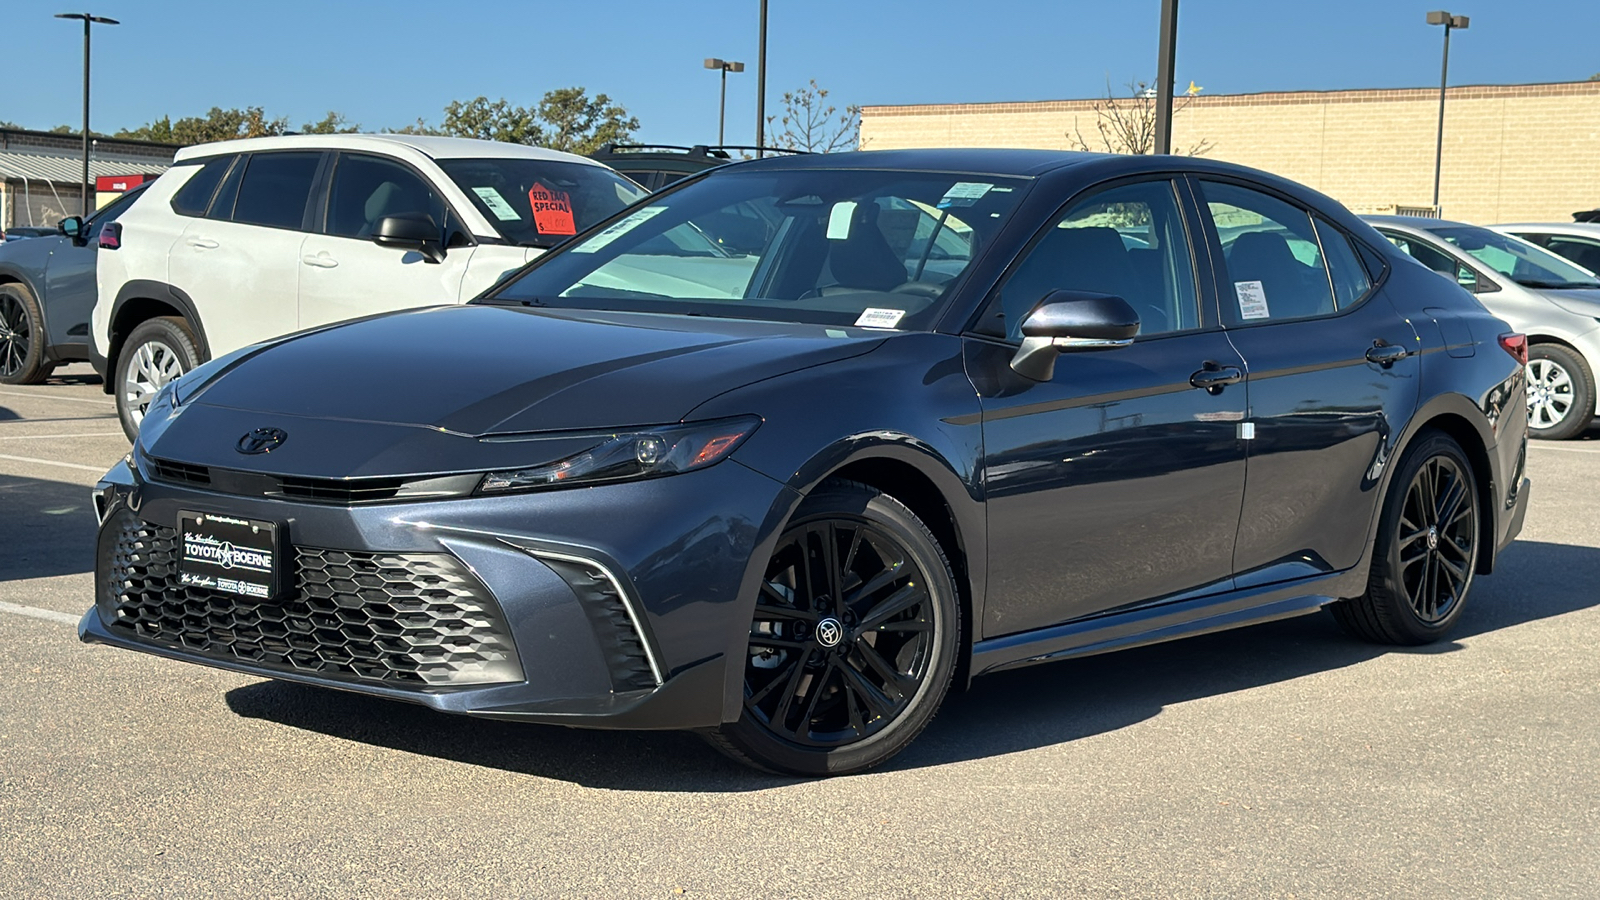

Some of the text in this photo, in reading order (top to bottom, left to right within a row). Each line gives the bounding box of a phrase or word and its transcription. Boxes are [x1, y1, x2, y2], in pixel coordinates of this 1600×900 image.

[533, 191, 565, 202] RED TAG
[534, 202, 569, 213] SPECIAL
[184, 543, 272, 568] TOYOTA BOERNE
[217, 580, 238, 590] TOYOTA
